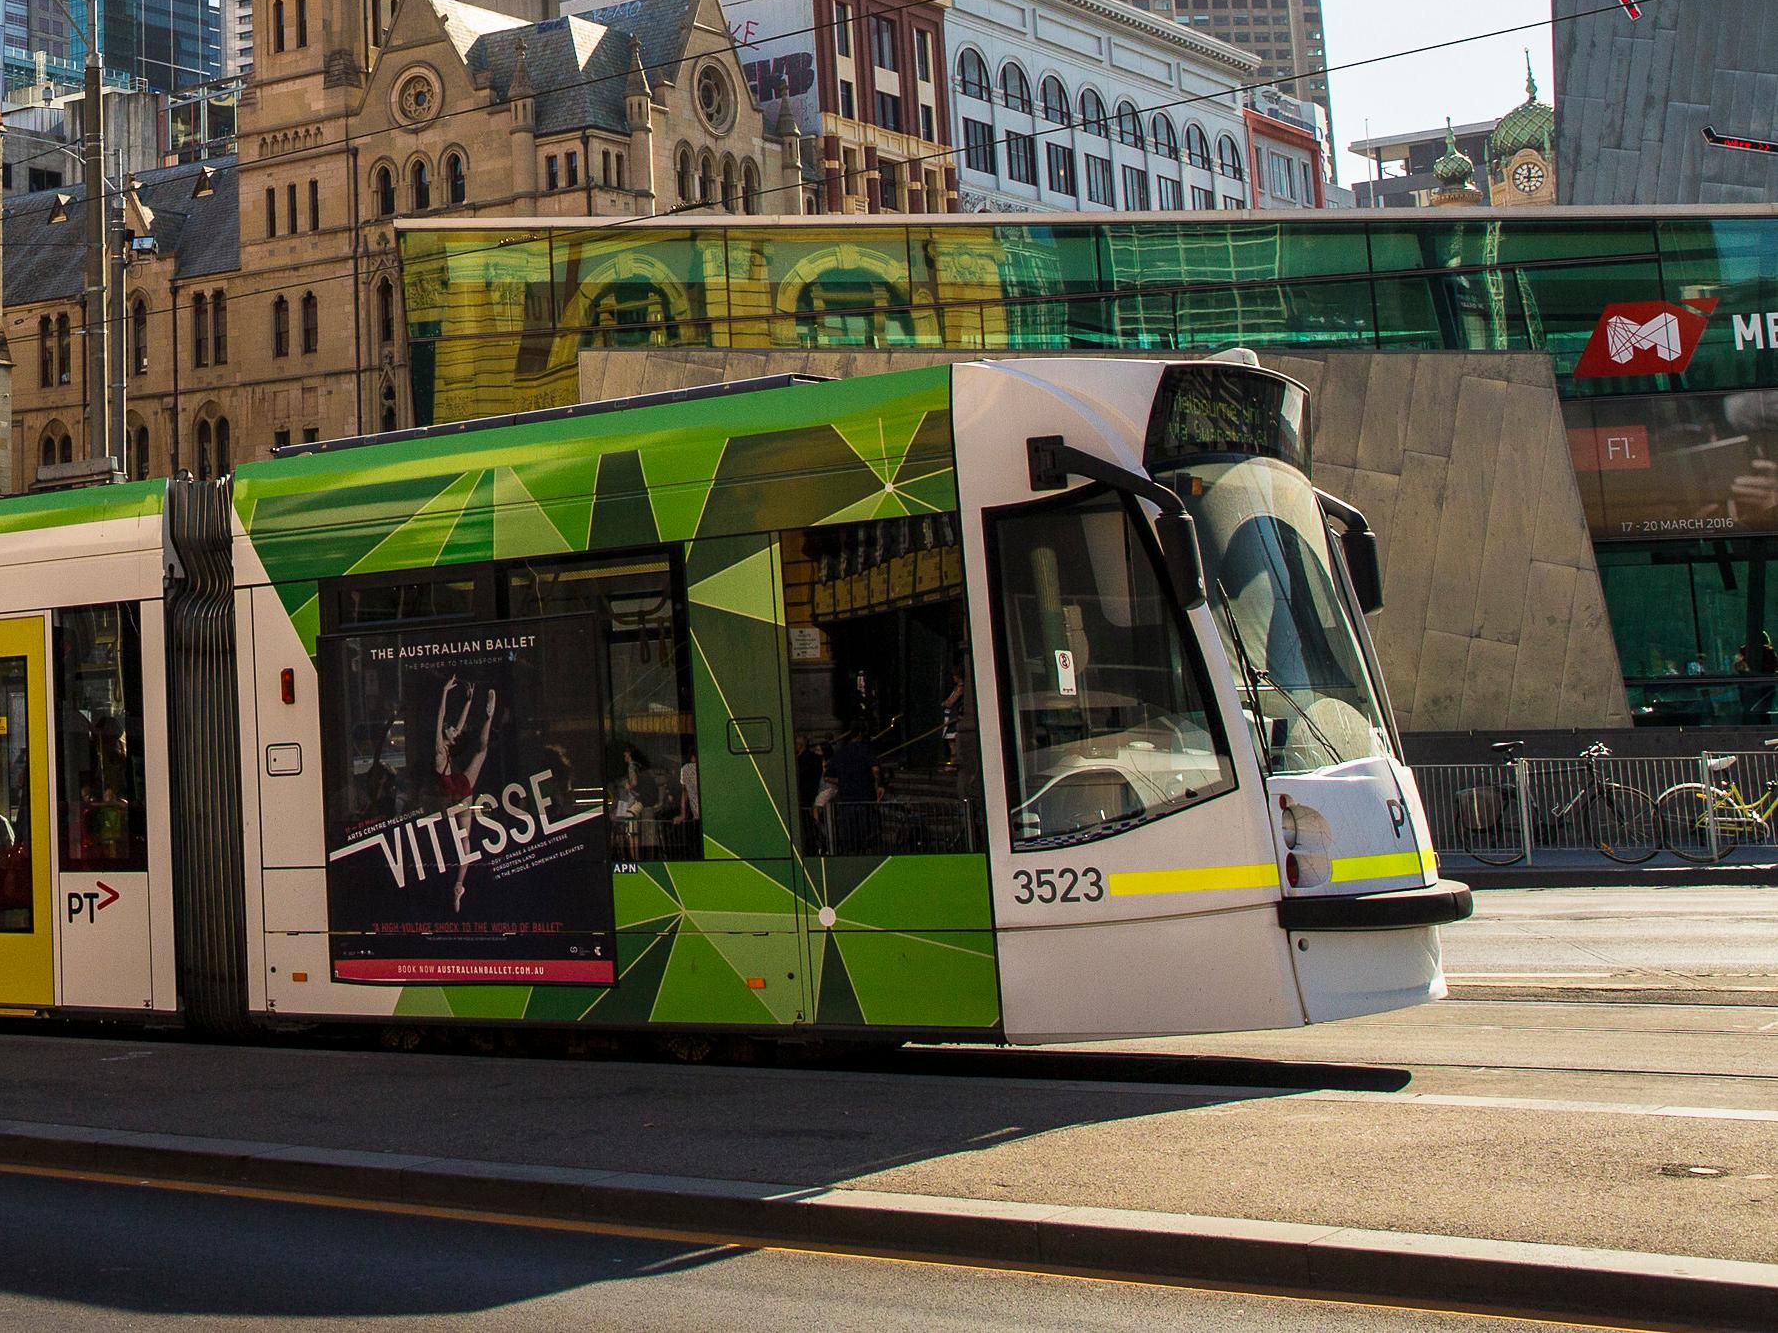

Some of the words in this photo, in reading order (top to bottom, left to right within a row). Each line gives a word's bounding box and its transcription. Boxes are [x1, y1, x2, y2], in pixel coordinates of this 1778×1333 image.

[1621, 521, 1633, 532] 17
[1643, 521, 1658, 531] 20
[1660, 519, 1704, 531] MARCH
[1706, 517, 1734, 528] 2016
[371, 648, 394, 660] THE
[398, 640, 481, 658] AUSTRALIAN
[486, 635, 536, 651] BALLET
[420, 661, 445, 670] POWER
[448, 659, 457, 667] TO
[459, 657, 503, 666] TRANSFORM
[329, 769, 604, 889] VITESSE
[347, 831, 363, 842] ARTS
[363, 821, 387, 835] CENTRE
[387, 807, 425, 827] MELBOURNE
[559, 843, 585, 857] ELEVATED
[522, 853, 537, 863] LAND
[613, 864, 637, 873] APN
[1013, 867, 1104, 904] 3523
[435, 922, 459, 933] SHOCK
[462, 922, 471, 933] TO
[474, 922, 488, 933] THE
[490, 922, 519, 933] WORLD
[397, 964, 418, 974] BOOK
[419, 965, 436, 975] NOW
[437, 965, 545, 976] AUSTRALIANBALLET.COM.AU
